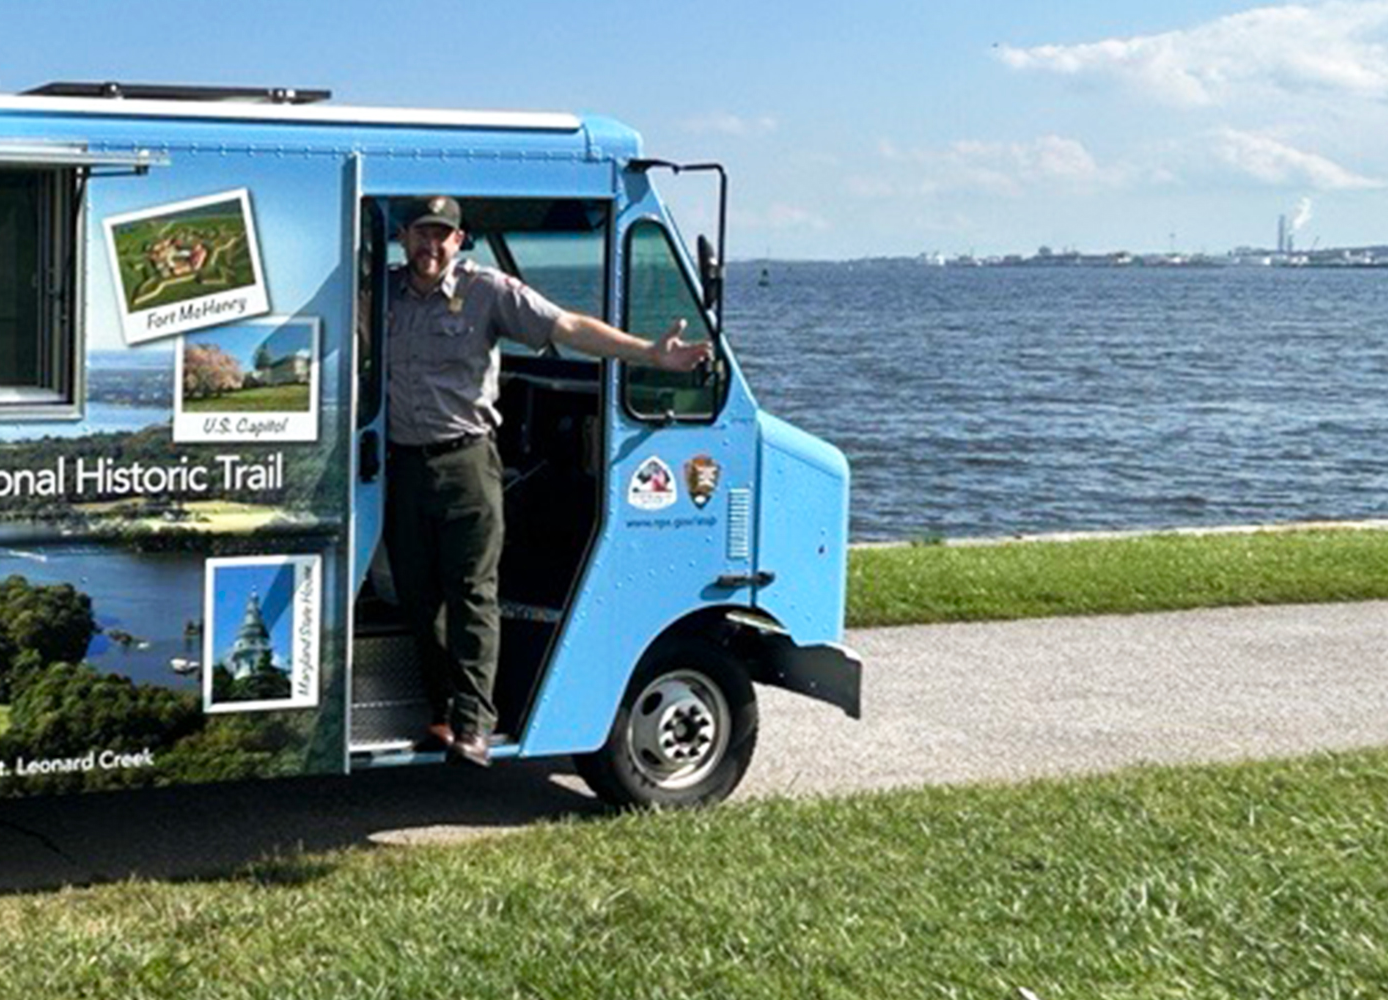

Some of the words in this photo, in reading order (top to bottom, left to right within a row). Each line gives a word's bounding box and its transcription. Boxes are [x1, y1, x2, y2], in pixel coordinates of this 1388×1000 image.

[147, 311, 176, 330] Fort
[236, 417, 289, 436] Capitol
[76, 456, 208, 495] Historic
[215, 453, 283, 491] Trail
[16, 751, 95, 776] Leonard
[99, 747, 155, 770] Creek
